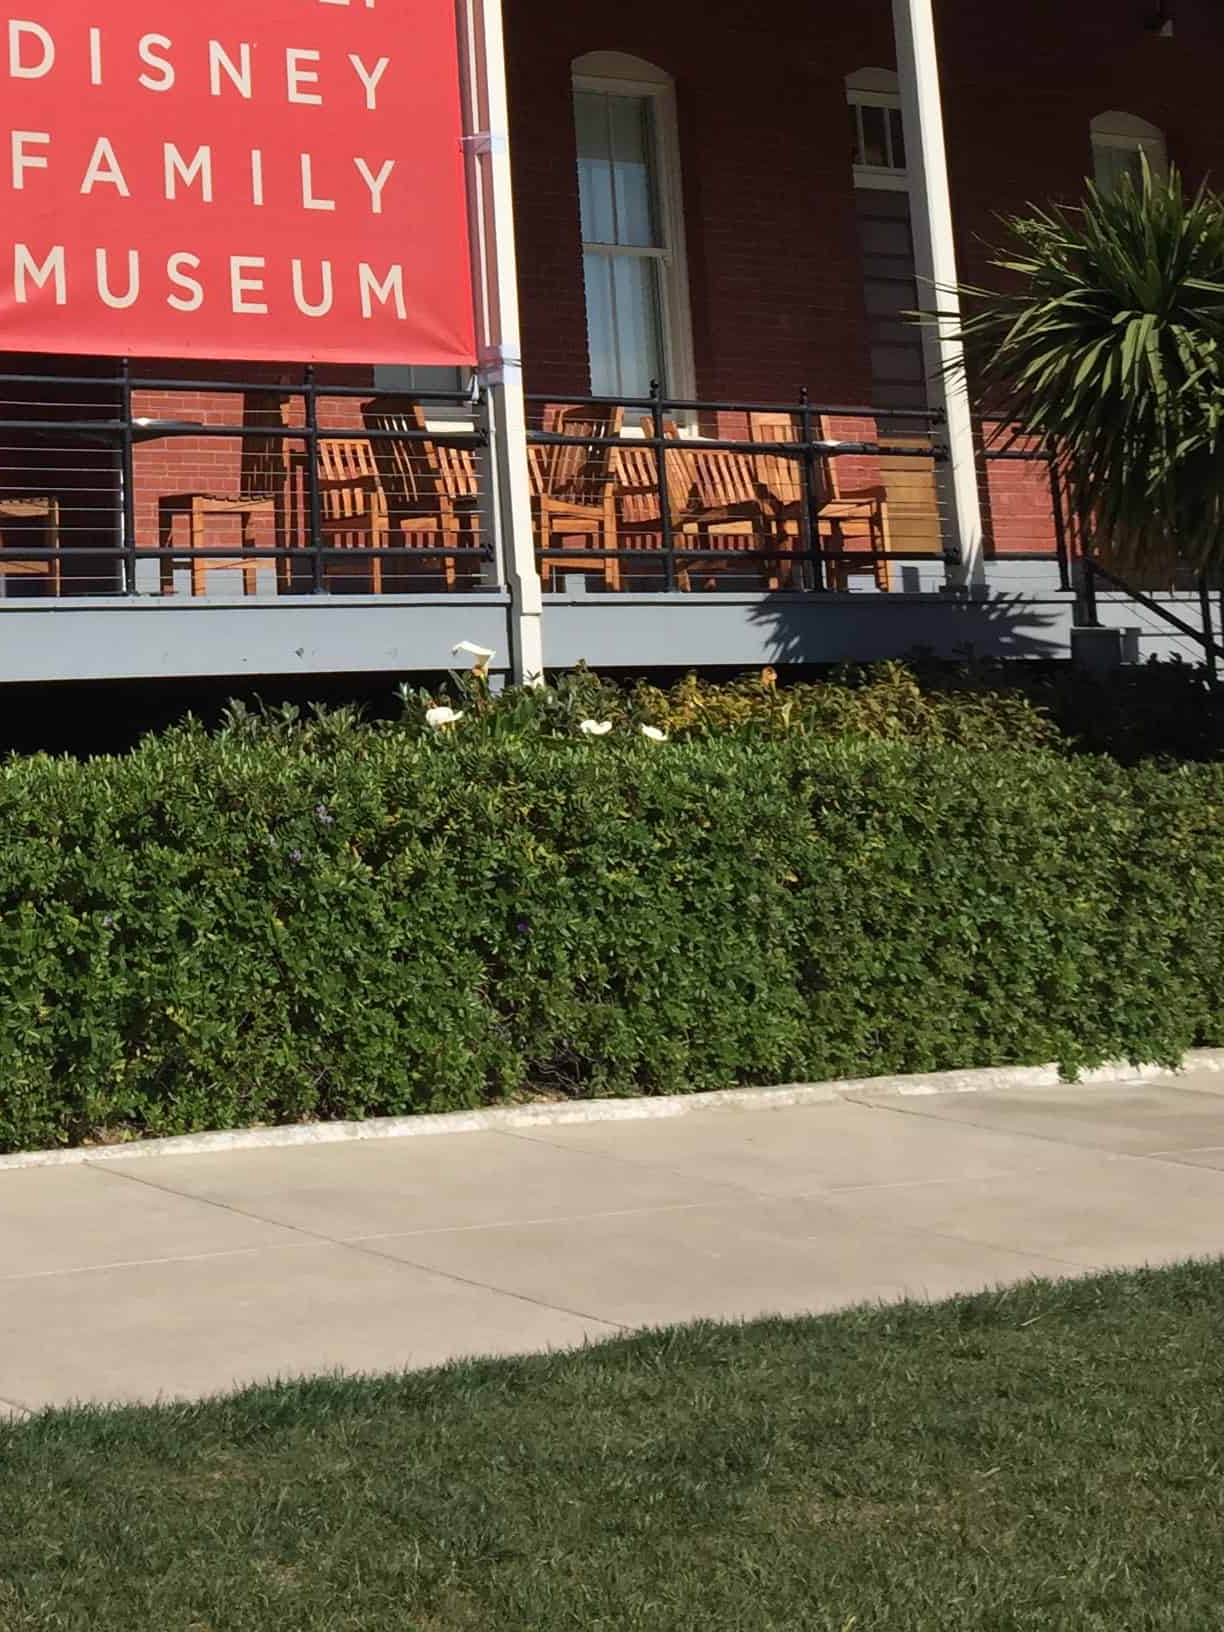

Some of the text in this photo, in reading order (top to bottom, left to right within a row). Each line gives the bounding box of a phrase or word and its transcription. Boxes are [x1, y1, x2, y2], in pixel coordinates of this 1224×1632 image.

[7, 18, 390, 110] DISNEY
[10, 130, 395, 214] FAMILY
[13, 242, 408, 320] MUSEUM
